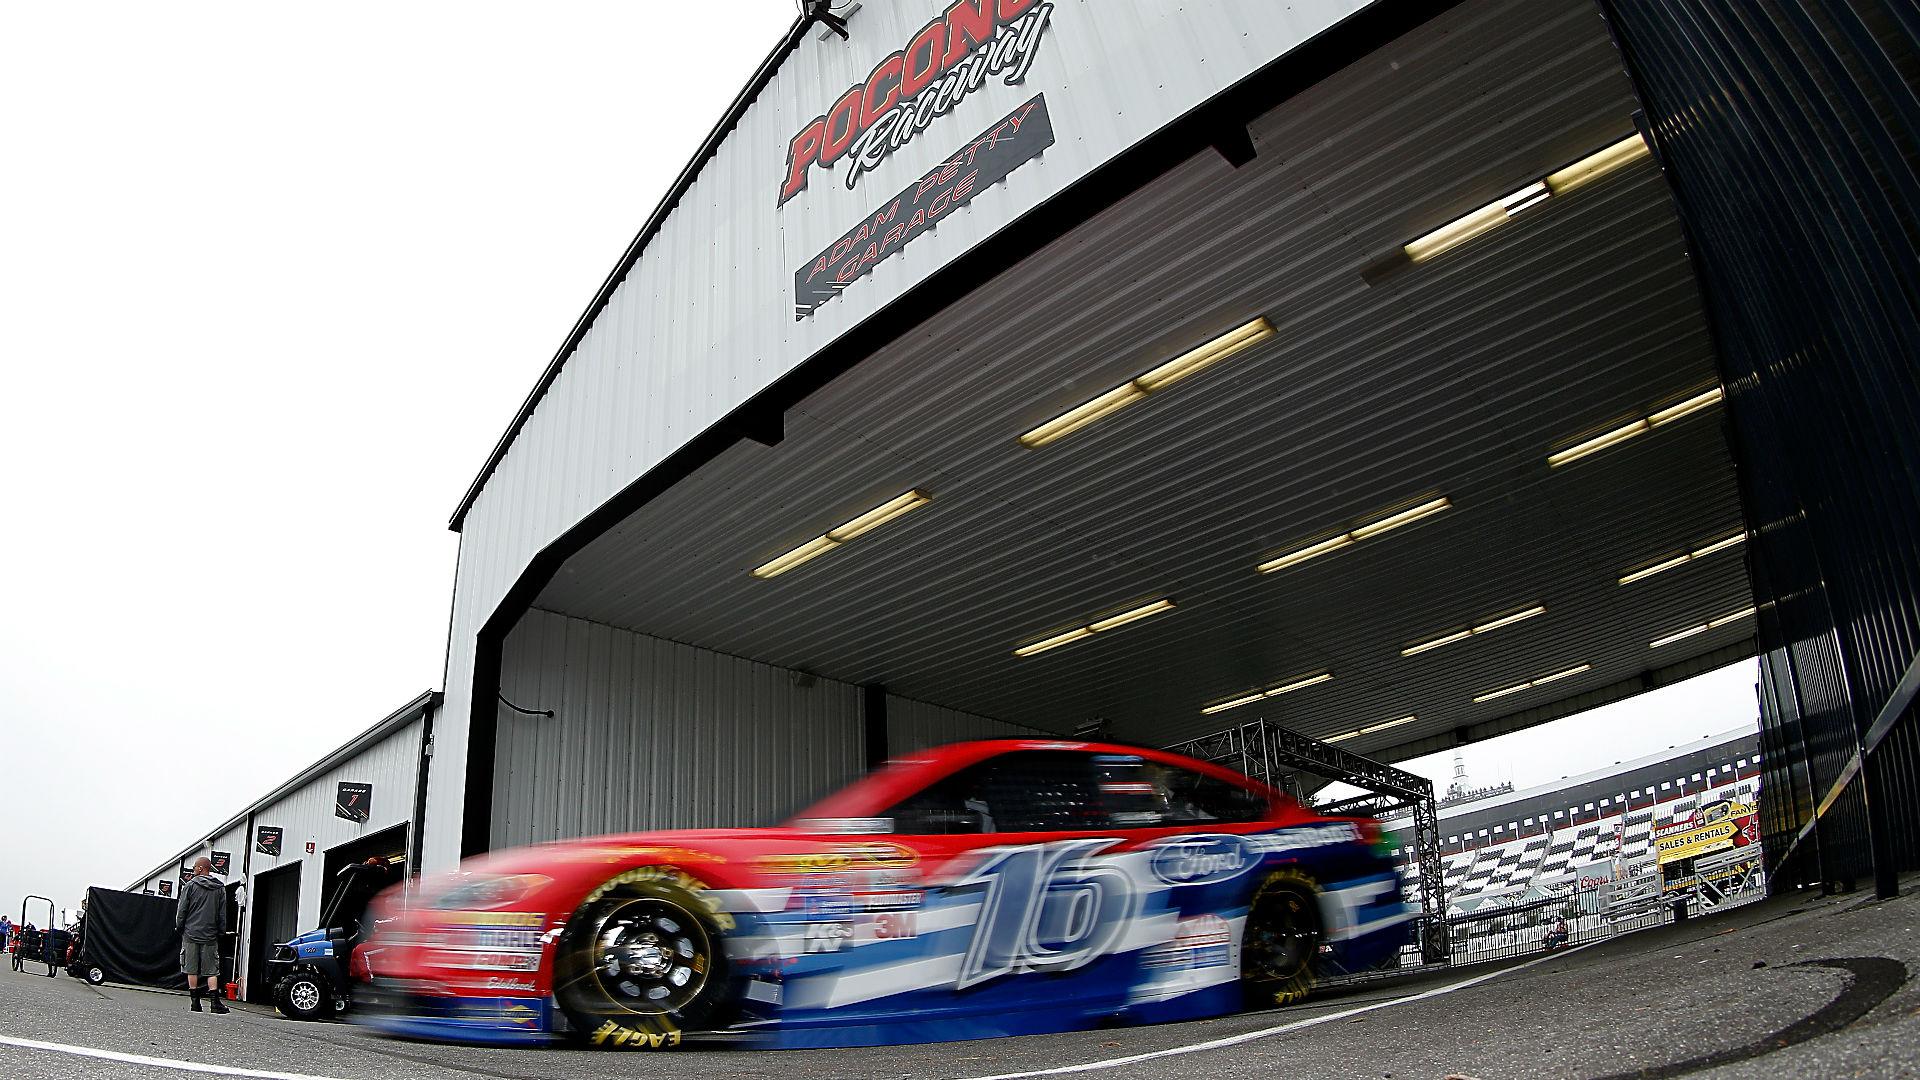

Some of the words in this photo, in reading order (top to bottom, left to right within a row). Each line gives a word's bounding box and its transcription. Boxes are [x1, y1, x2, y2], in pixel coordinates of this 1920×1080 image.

[779, 0, 1043, 206] POCON
[846, 3, 1053, 188] Raceway
[806, 199, 900, 283] ADAM
[913, 102, 1037, 204] PETTY
[837, 168, 978, 283] GARAGE
[1177, 842, 1246, 880] Ford
[1656, 821, 1694, 838] SCANNERS
[1660, 838, 1685, 851] SALES
[1686, 836, 1692, 844] &
[1694, 826, 1730, 842] RENTALS
[874, 913, 918, 938] 3M
[955, 838, 1137, 991] 16
[592, 1019, 682, 1047] EAGLE
